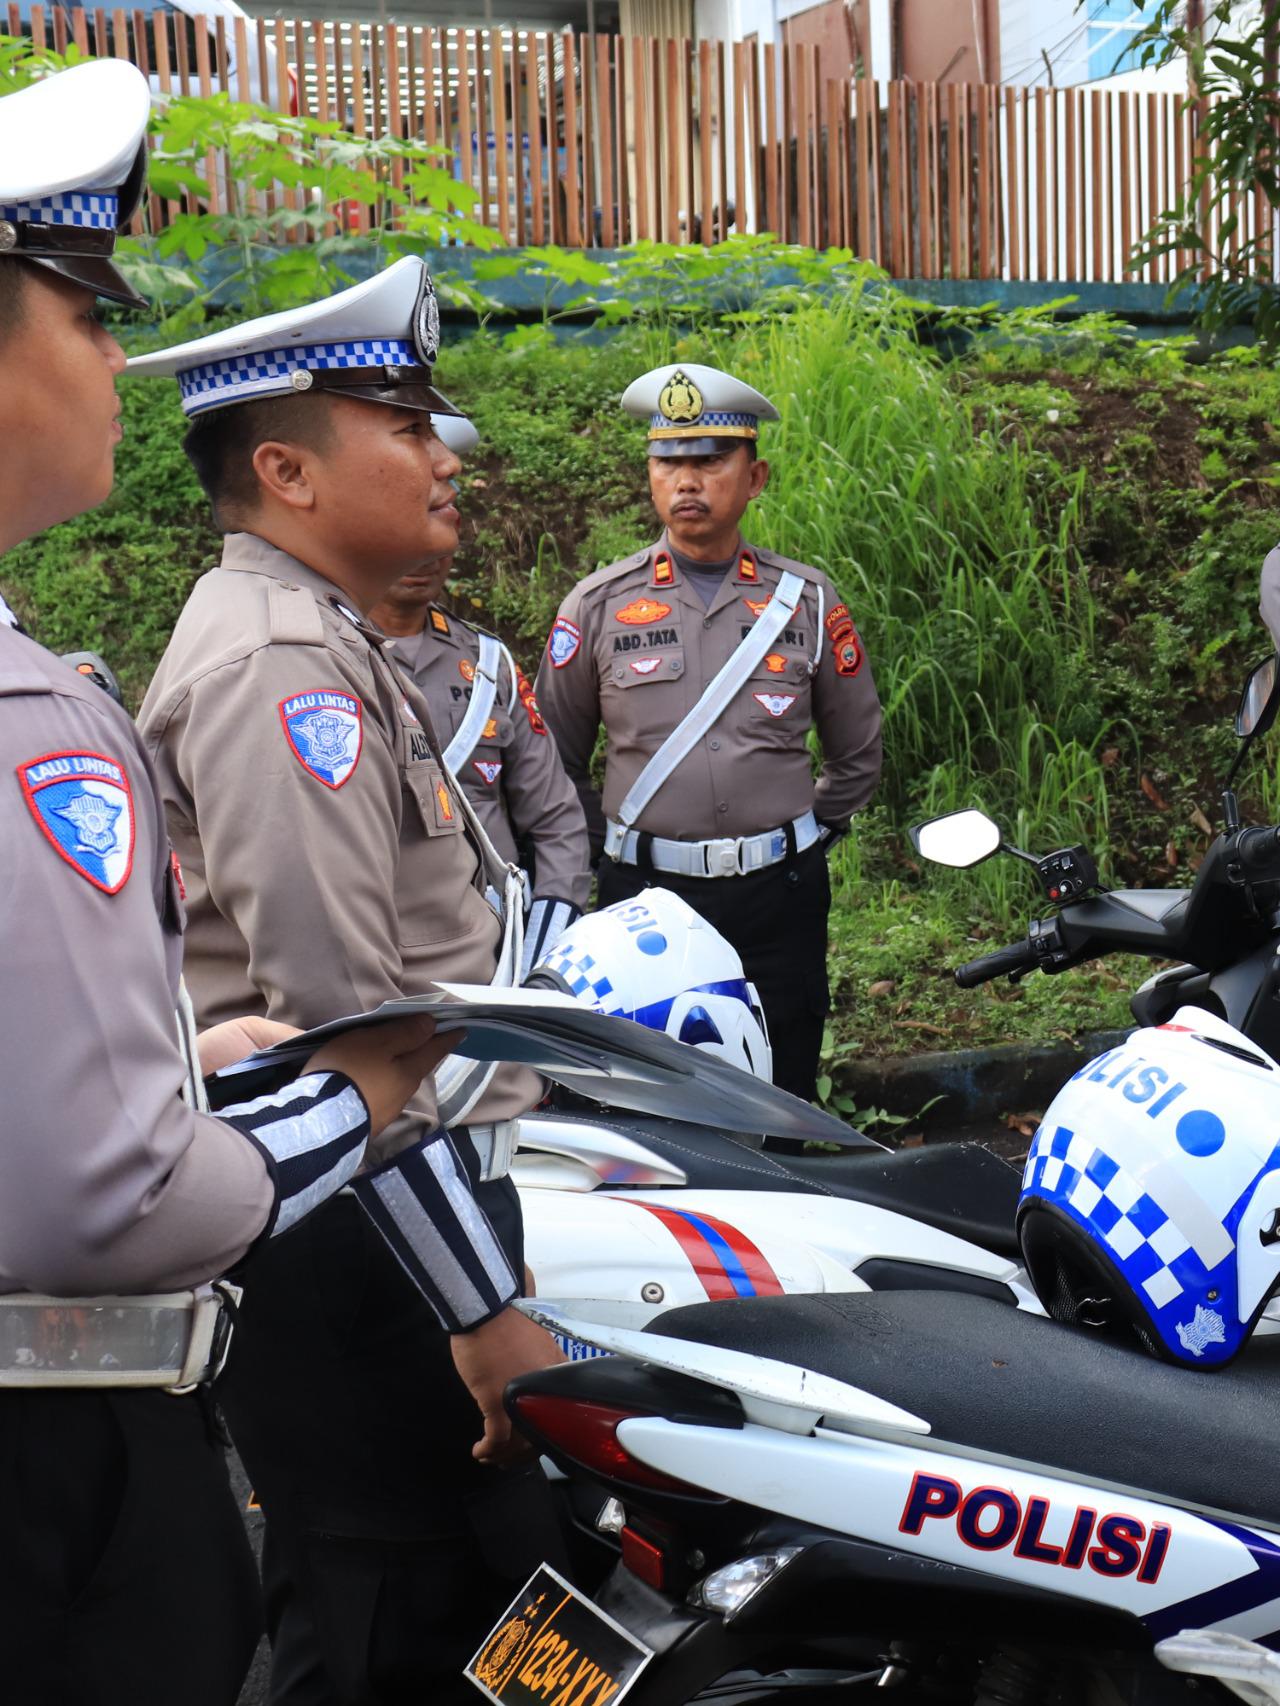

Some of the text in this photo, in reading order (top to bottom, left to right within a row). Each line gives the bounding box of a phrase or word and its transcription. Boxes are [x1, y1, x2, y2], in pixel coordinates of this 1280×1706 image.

[613, 628, 679, 653] ABD.TATA
[285, 694, 356, 714] LALU LINTAS
[26, 757, 121, 783] LALU LINTAS
[1072, 1051, 1188, 1120] LISI
[898, 1470, 1171, 1584] POLISI
